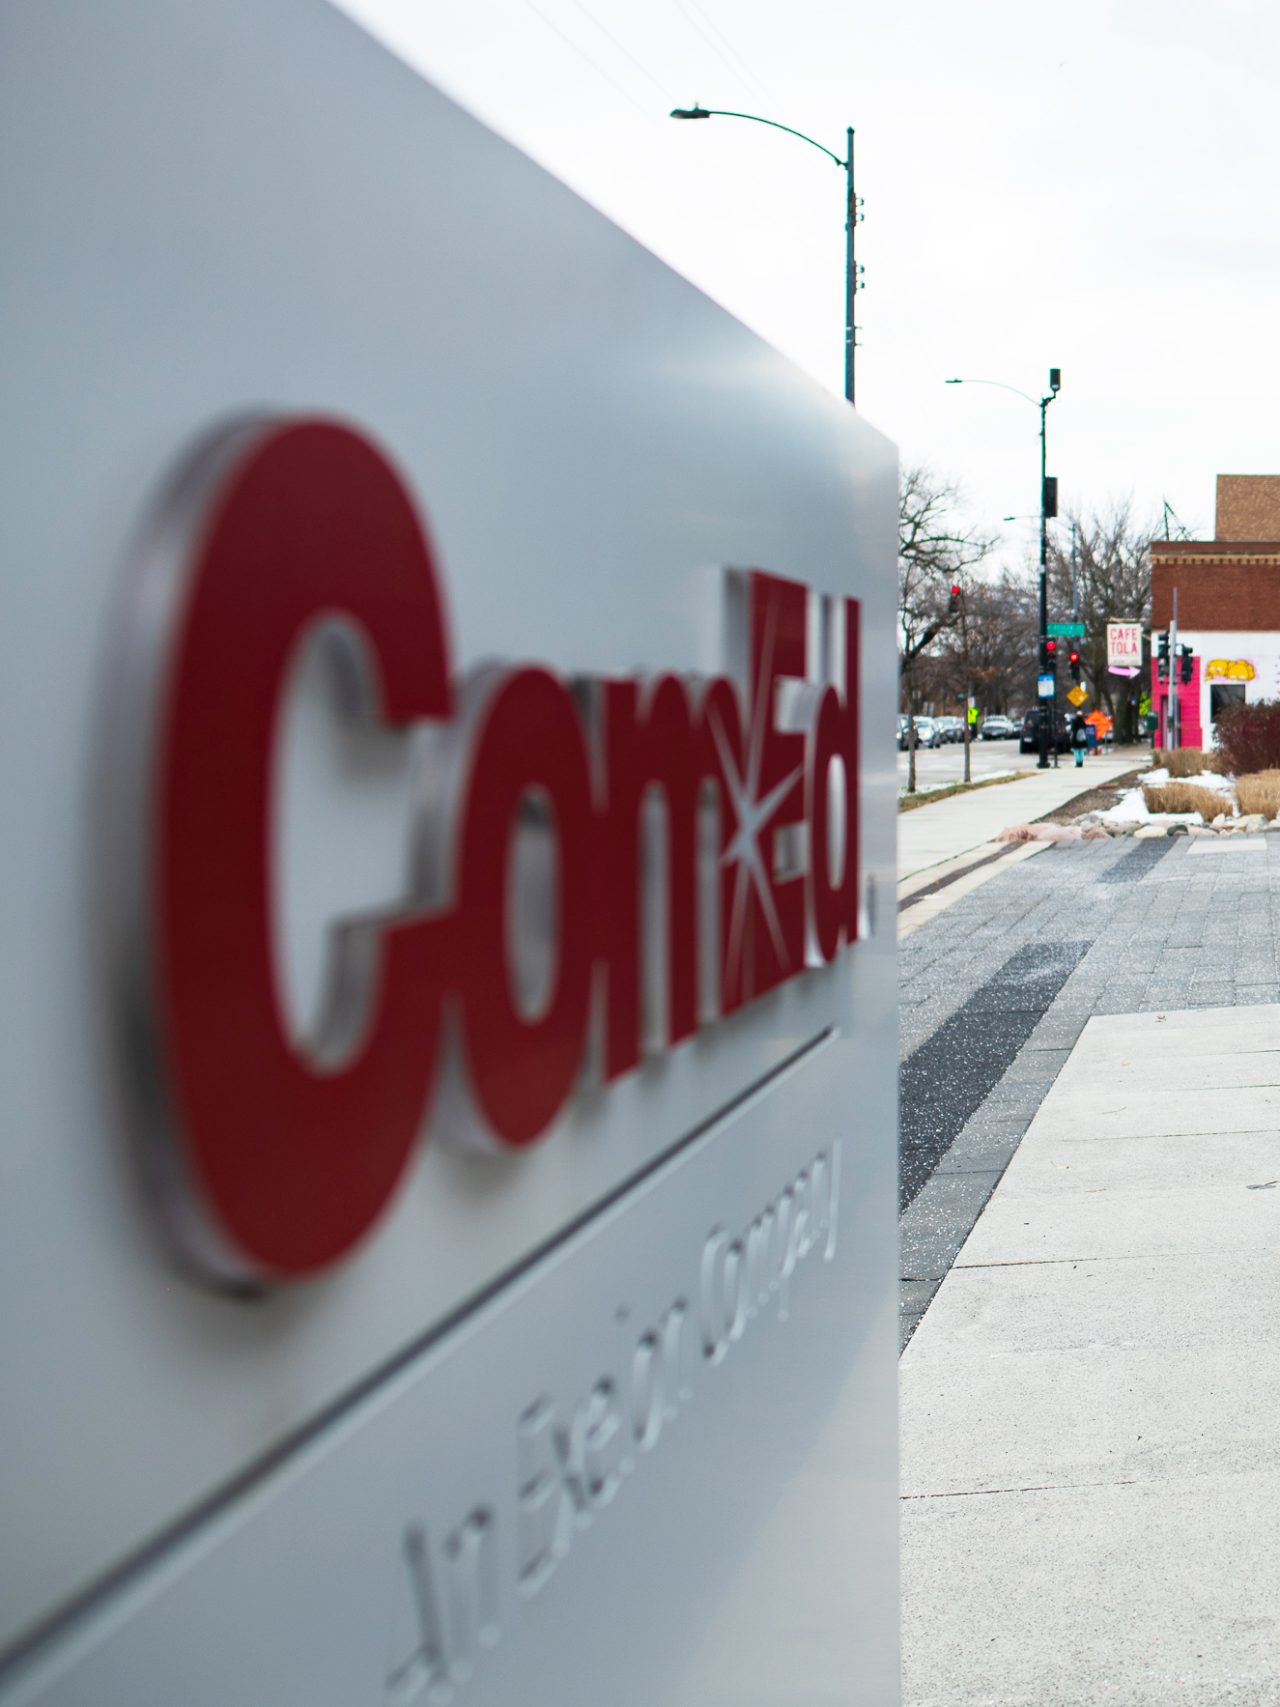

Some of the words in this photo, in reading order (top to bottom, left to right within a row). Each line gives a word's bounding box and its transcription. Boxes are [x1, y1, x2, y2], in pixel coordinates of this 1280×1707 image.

[1110, 628, 1138, 640] CAFE
[1111, 642, 1138, 654] TOLA
[158, 415, 864, 1279] ComEd
[384, 1506, 502, 1706] An
[699, 1138, 845, 1366] Company
